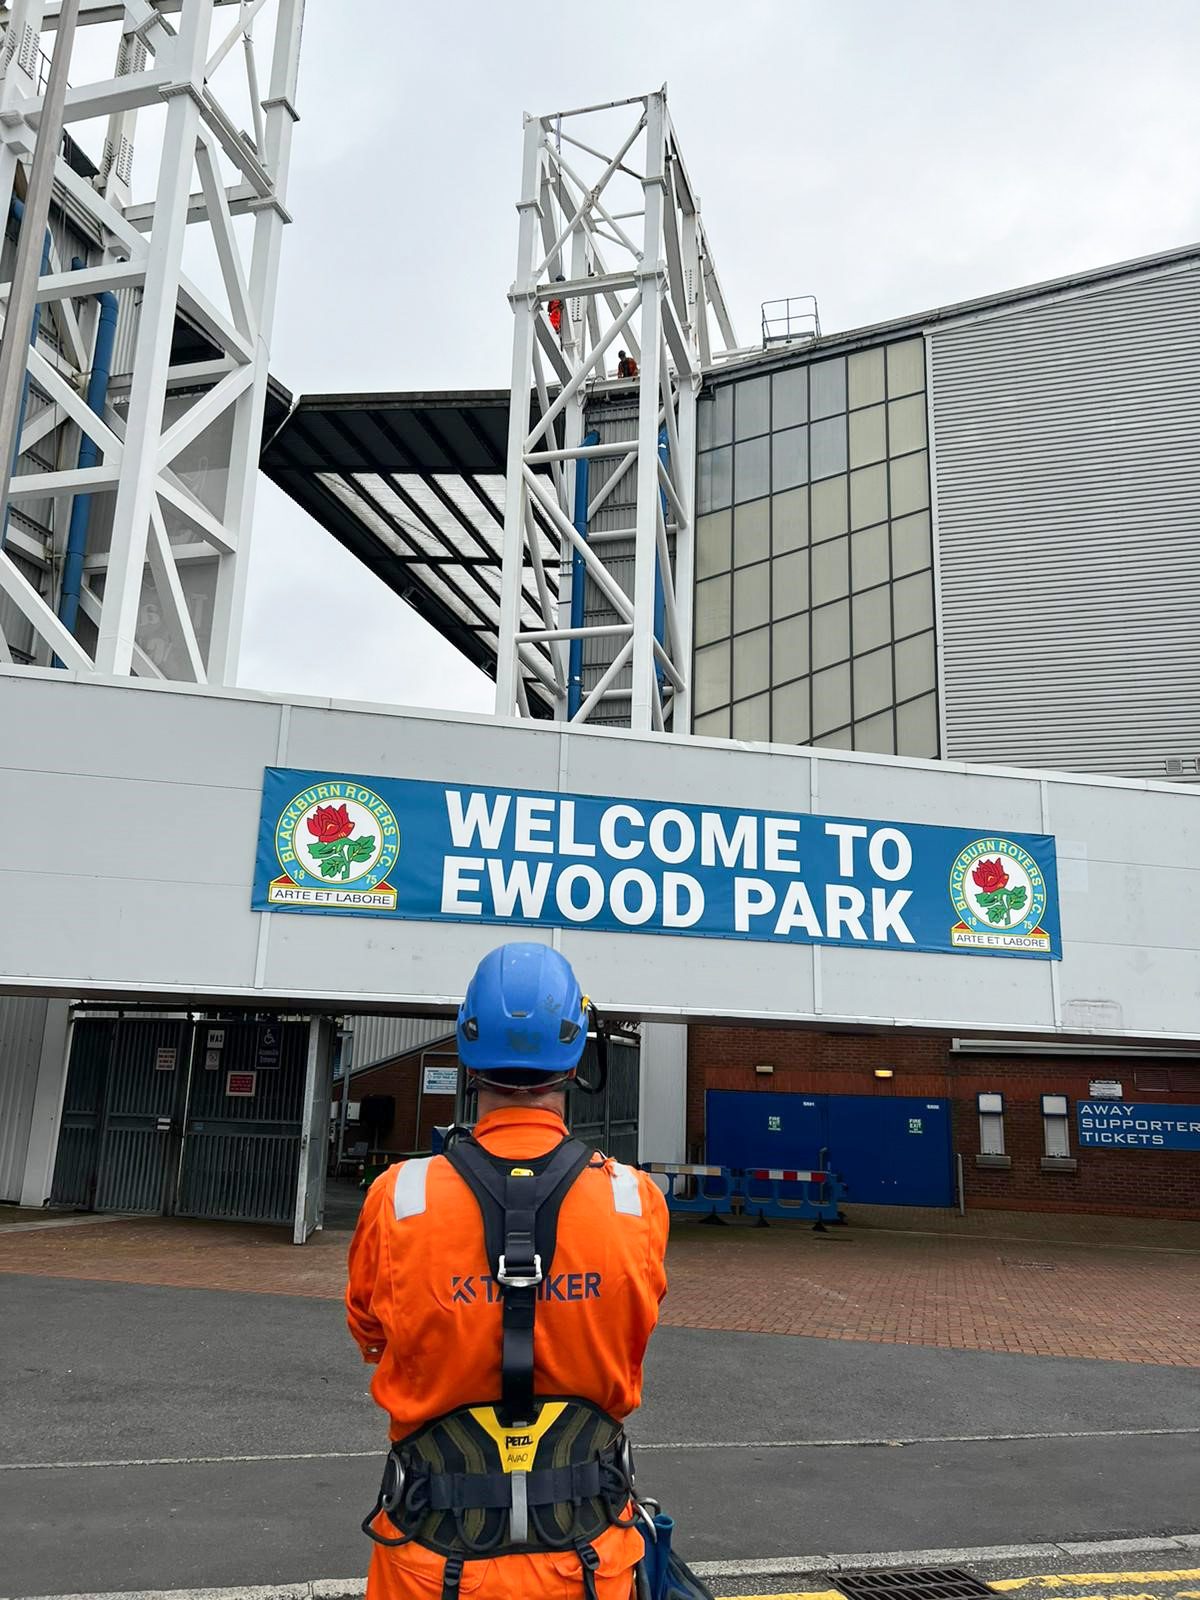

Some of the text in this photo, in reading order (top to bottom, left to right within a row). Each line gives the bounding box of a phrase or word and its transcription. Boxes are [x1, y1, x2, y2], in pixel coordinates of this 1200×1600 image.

[280, 785, 340, 862] BLACKBURN
[345, 785, 396, 836] ROVERS
[445, 790, 913, 882] WELCOME TO
[293, 870, 377, 884] 18 75
[953, 841, 995, 911] BLACKBURN
[998, 841, 1041, 886] ROVERS
[275, 889, 391, 905] ARTE ET LABORE
[440, 855, 916, 943] EWOOD PARK
[956, 934, 1045, 947] ARTE ET LABORE
[1081, 1105, 1134, 1115] AWAY
[1082, 1132, 1164, 1144] TICKETS
[480, 1272, 601, 1303] TKER
